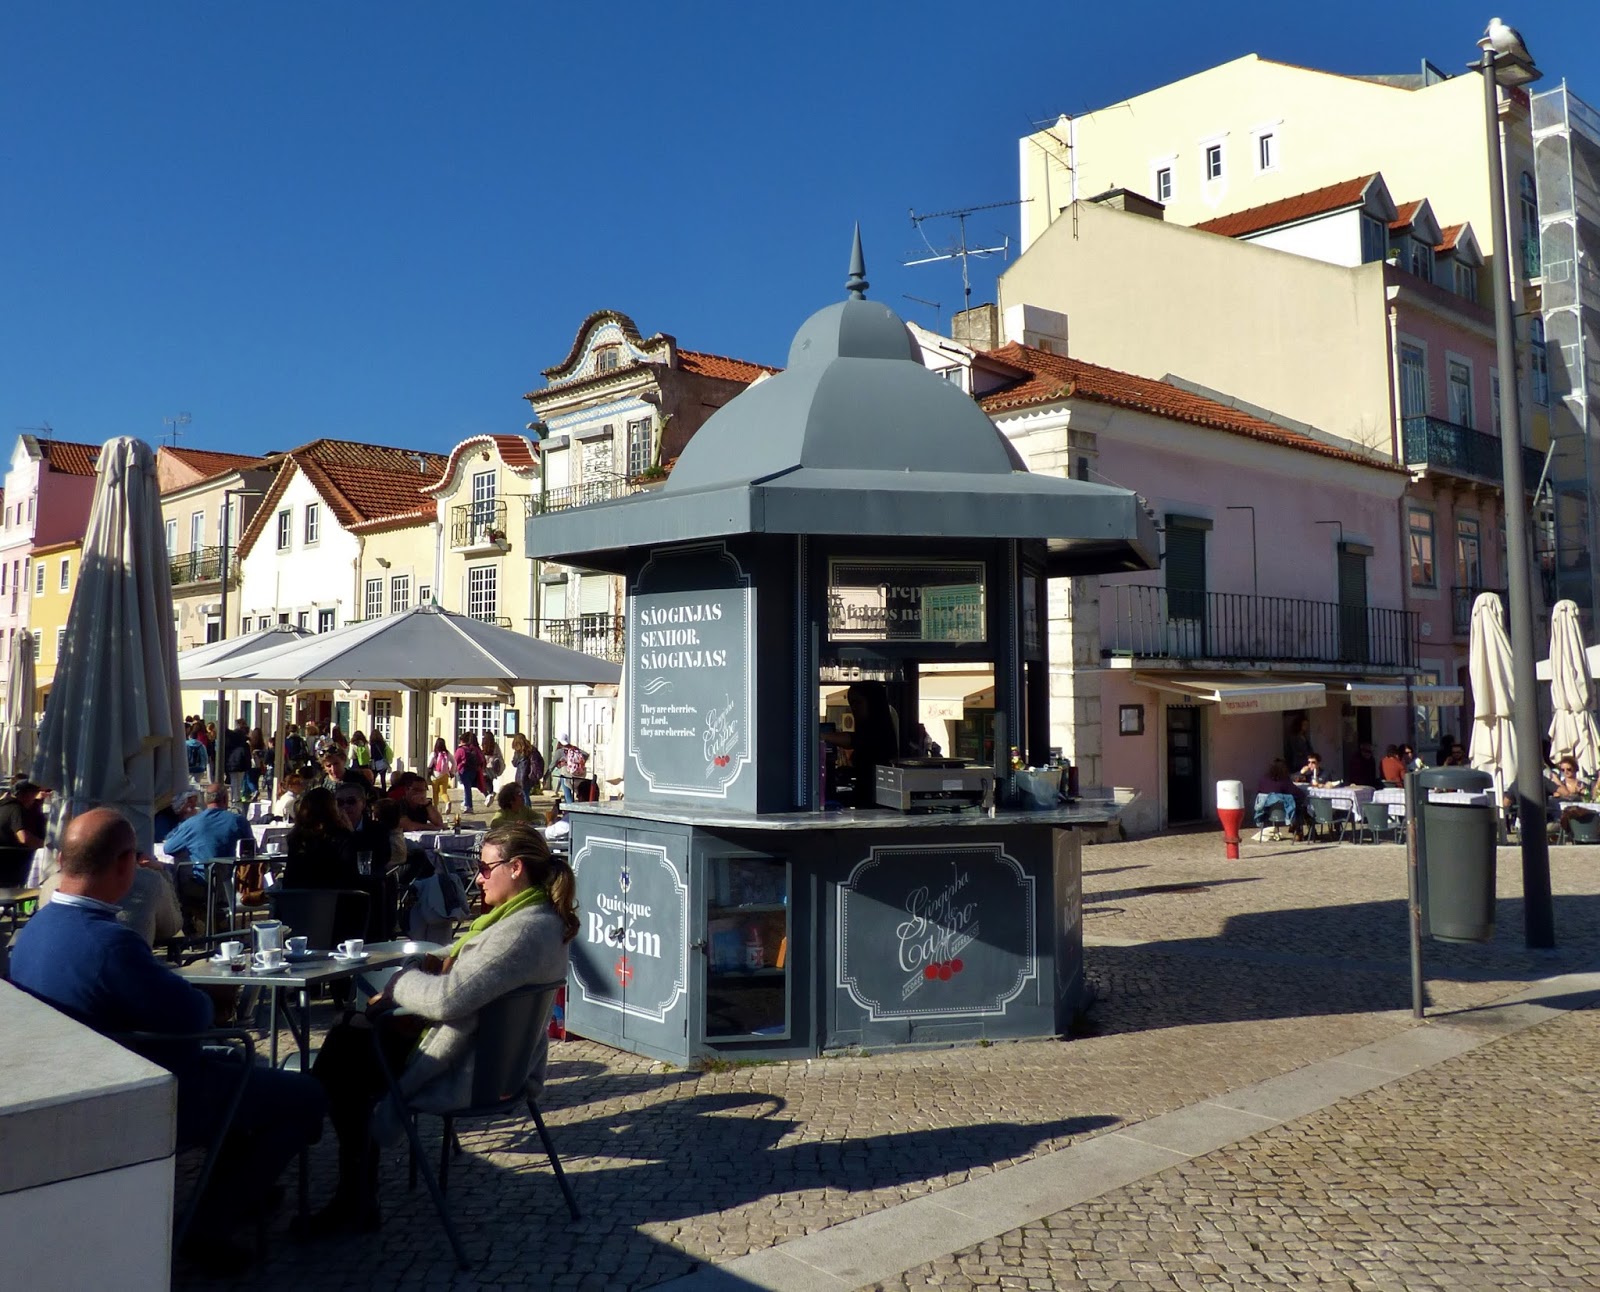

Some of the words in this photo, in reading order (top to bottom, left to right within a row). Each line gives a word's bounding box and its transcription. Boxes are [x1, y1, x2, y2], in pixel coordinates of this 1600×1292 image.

[641, 606, 667, 625] SÃO
[668, 603, 722, 623] GINJAS
[641, 650, 667, 669] SÃO
[668, 649, 726, 668] GINJAS!
[640, 704, 656, 715] They
[656, 706, 667, 714] are
[640, 717, 650, 726] my
[640, 727, 653, 738] they
[654, 729, 665, 737] are
[665, 727, 696, 737] cherries!
[596, 893, 651, 920] Quiosque
[905, 861, 968, 938] Ginginha
[587, 911, 661, 958] Belém
[896, 902, 978, 972] Carmo
